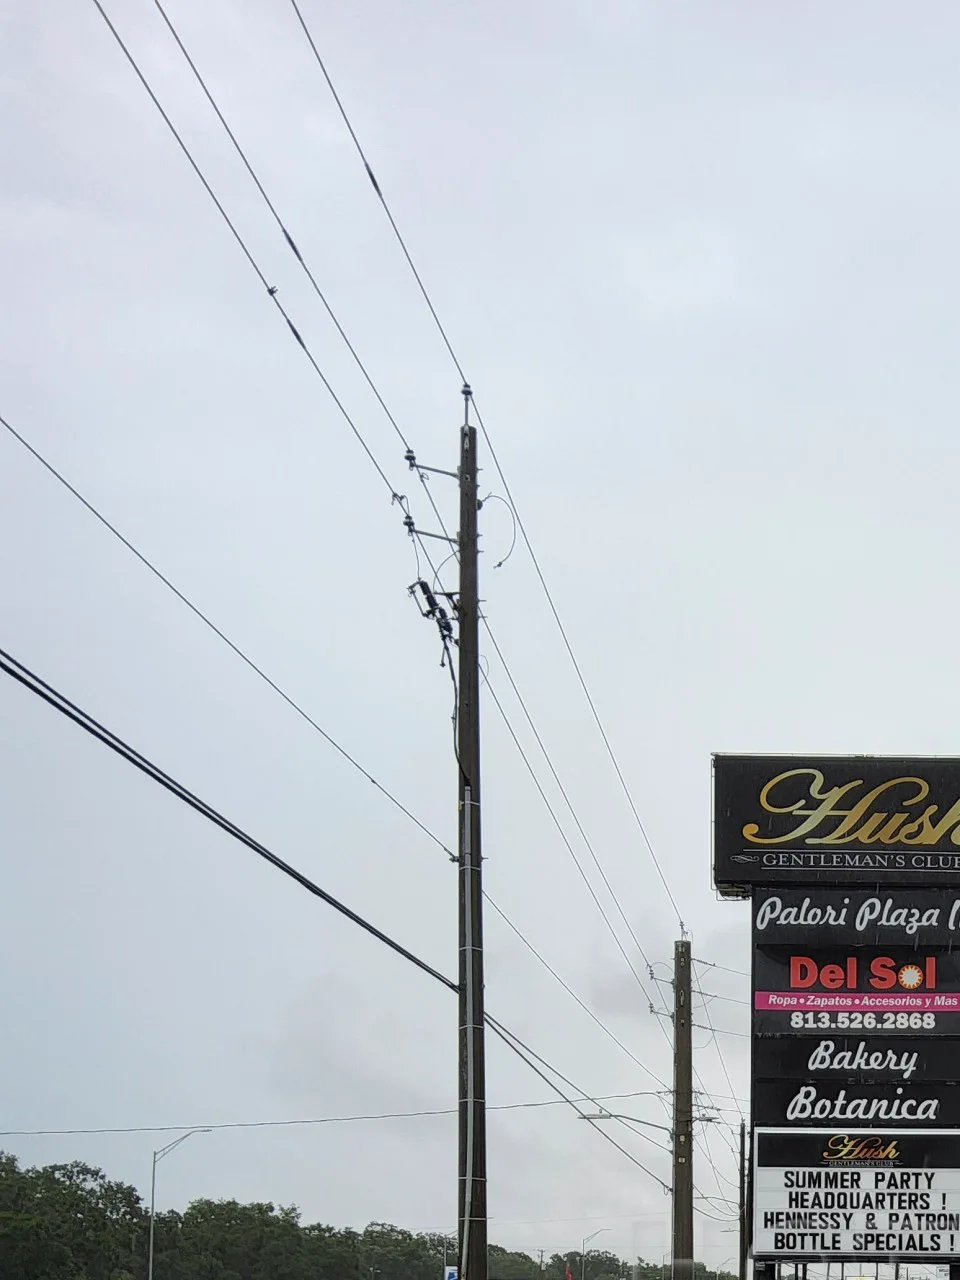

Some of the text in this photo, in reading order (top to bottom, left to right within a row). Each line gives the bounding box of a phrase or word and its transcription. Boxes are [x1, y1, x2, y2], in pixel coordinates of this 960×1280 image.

[762, 853, 905, 868] GENTLEMAN'S
[756, 896, 850, 930] Palori
[855, 897, 939, 934] Plaza
[790, 956, 936, 990] Del Sol
[768, 994, 958, 1008] Ropa Zapatos Accesorios y Mas
[790, 1011, 936, 1029] 813.526.2868
[808, 1040, 918, 1079] Bakery
[786, 1086, 939, 1120] Botanica
[823, 1134, 900, 1159] Hush
[784, 1171, 935, 1189] SUMMER PARTY
[788, 1191, 930, 1210] HEADQUARTERS
[764, 1211, 960, 1231] HENNESSY & PATRON
[774, 1232, 841, 1250] BOTTLE
[853, 1233, 941, 1251] SPECIALS
